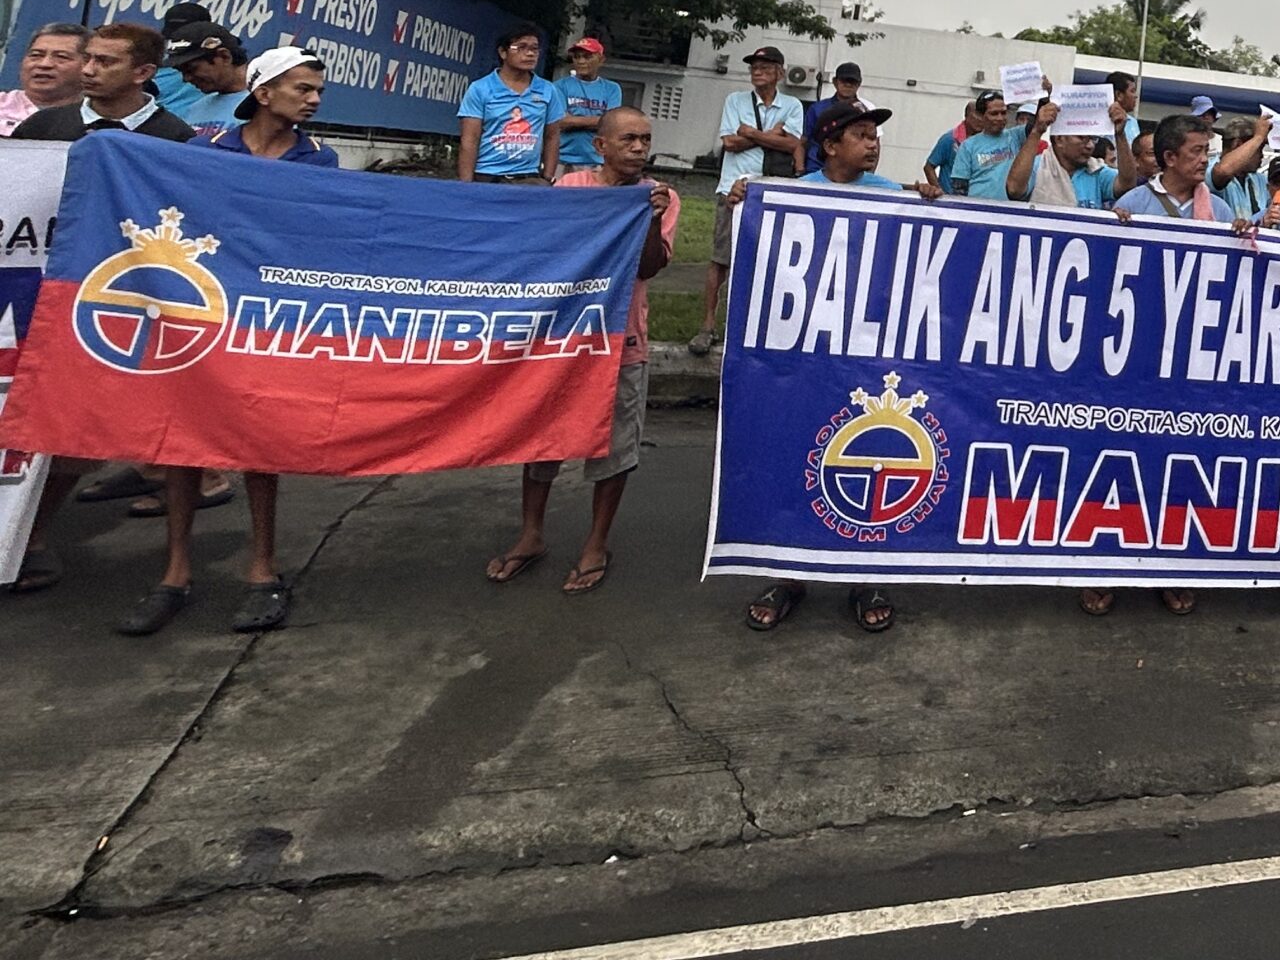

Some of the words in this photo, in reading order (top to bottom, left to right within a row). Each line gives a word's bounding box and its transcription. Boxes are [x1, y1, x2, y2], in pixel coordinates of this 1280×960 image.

[411, 14, 475, 76] PRODUKTO
[259, 266, 424, 295] TRANSPORTASYON.
[525, 277, 611, 298] KAUNLARAN
[743, 210, 958, 361] IBALIK
[959, 231, 1090, 372] ANG
[1103, 245, 1142, 376] 5
[225, 295, 611, 365] MANIBELA
[805, 407, 853, 490] NOVA
[996, 398, 1254, 438] TRANSPORTASYON.
[896, 412, 950, 534] CHAPTER
[811, 496, 886, 542] BLUM
